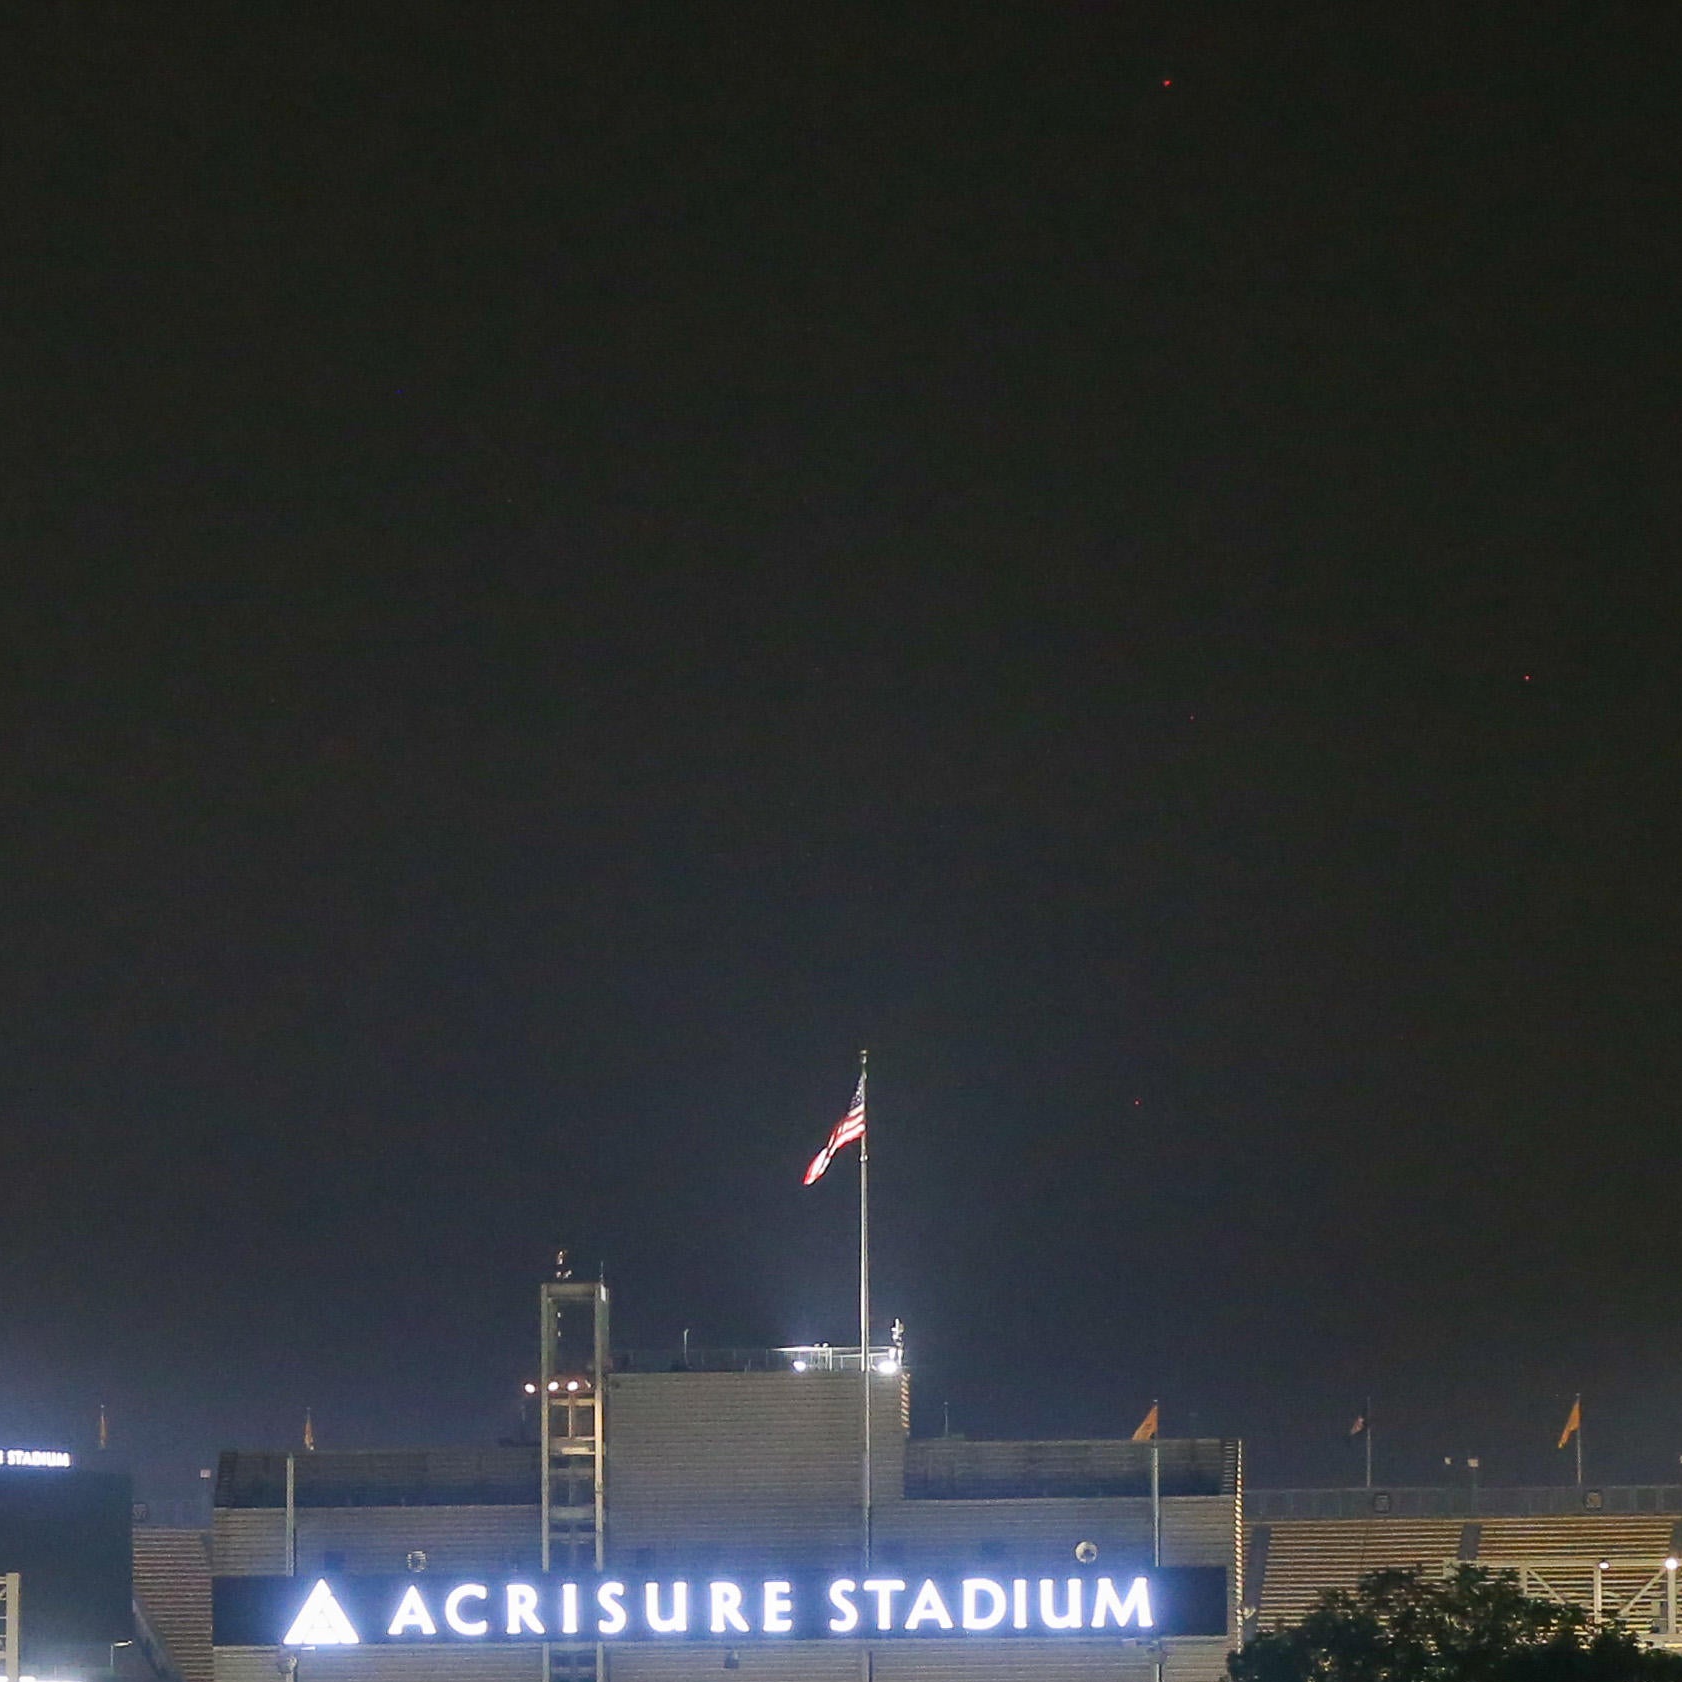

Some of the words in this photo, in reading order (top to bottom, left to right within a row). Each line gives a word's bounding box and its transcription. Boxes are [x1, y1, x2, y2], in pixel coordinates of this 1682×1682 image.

[6, 1449, 70, 1467] STADIUM
[386, 1580, 794, 1636] ACRISURE
[828, 1577, 1155, 1633] STADIUM
